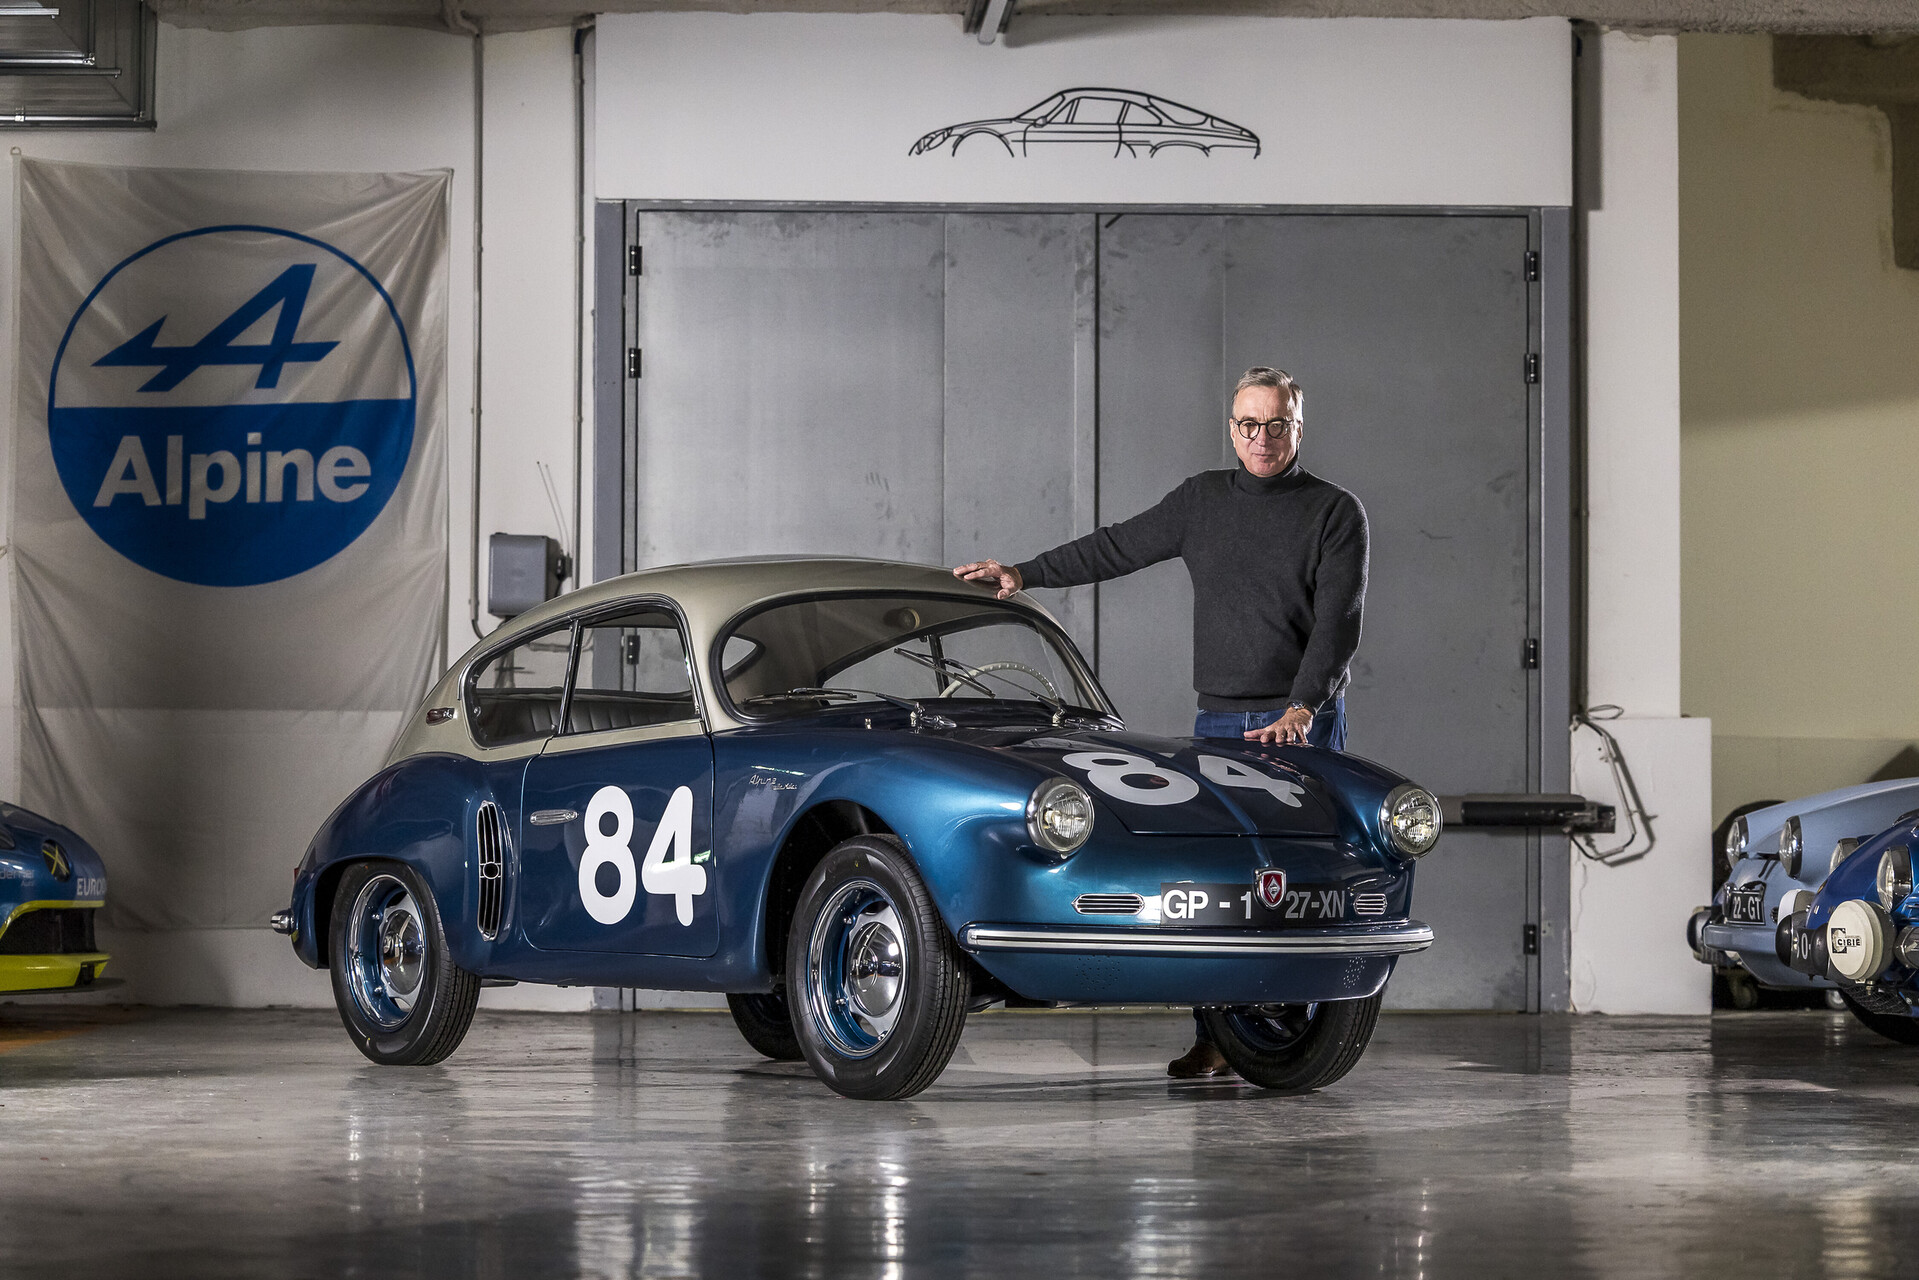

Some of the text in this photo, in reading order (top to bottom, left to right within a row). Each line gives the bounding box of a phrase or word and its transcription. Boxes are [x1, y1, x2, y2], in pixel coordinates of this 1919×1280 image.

[92, 432, 371, 519] Alpine
[1062, 752, 1305, 808] 84
[578, 785, 707, 927] 84
[1162, 889, 1209, 920] GP
